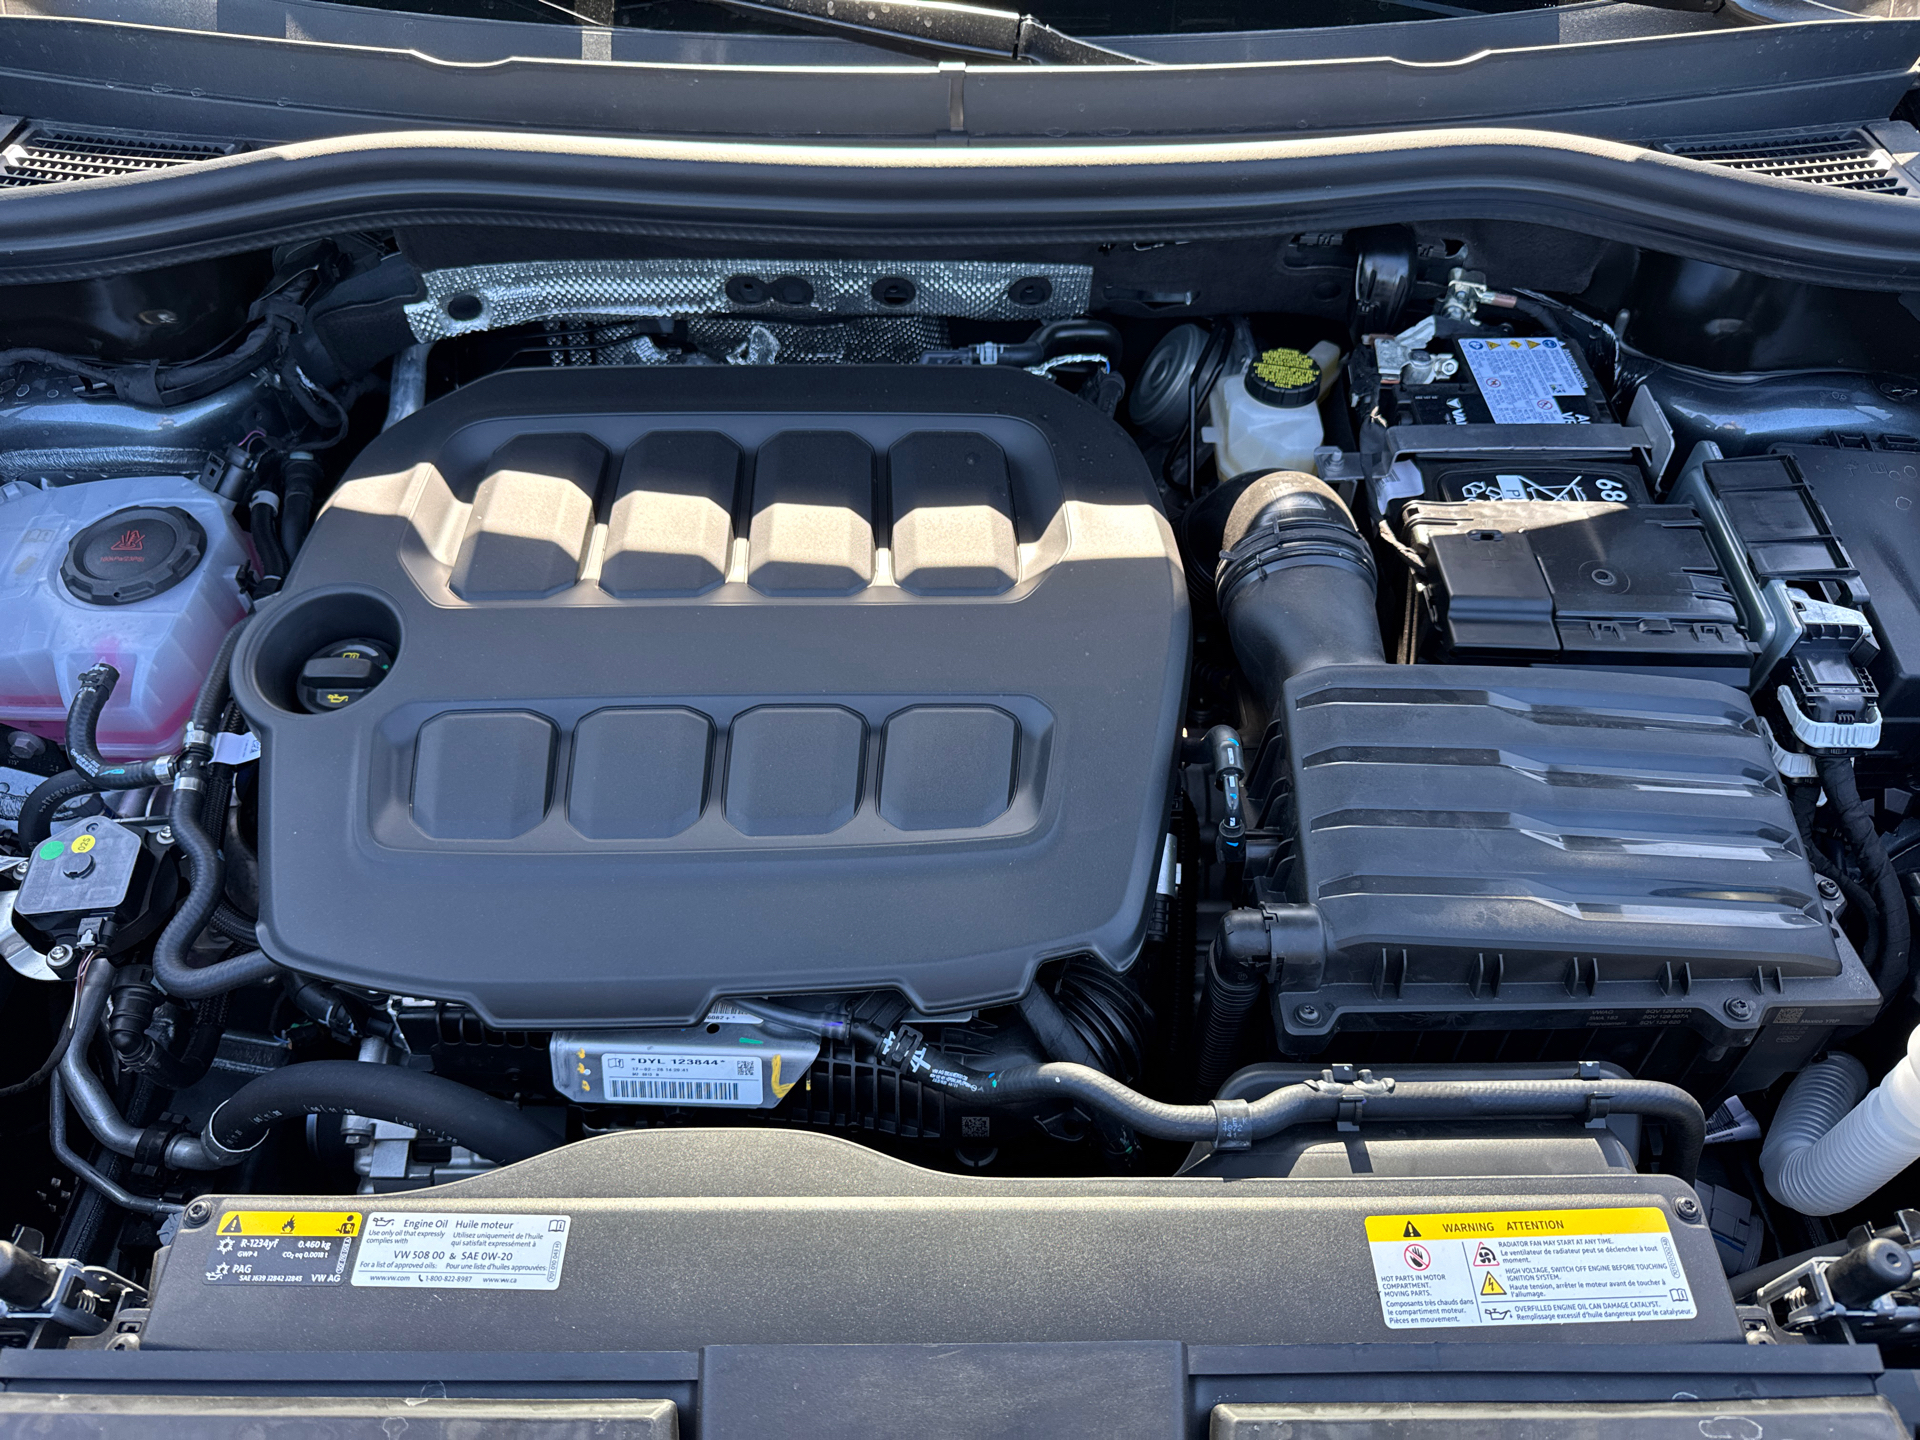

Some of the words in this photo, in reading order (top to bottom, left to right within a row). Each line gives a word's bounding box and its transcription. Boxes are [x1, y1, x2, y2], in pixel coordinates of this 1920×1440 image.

[1595, 478, 1629, 502] 68
[404, 1220, 434, 1230] Engine
[435, 1220, 448, 1228] Oil
[455, 1220, 479, 1229] Huile
[1442, 1222, 1494, 1233] WARNING
[1506, 1220, 1564, 1231] ATTENTION
[477, 1232, 515, 1241] uniquement
[240, 1238, 279, 1250] R-1234yf
[298, 1240, 320, 1248] 0.460
[321, 1240, 331, 1250] kg
[488, 1240, 531, 1248] expressément
[394, 1250, 411, 1259] VW
[412, 1251, 430, 1259] 508
[432, 1251, 445, 1260] 00
[461, 1252, 479, 1260] SAE
[481, 1252, 513, 1261] 0W-20
[232, 1264, 252, 1274] PAG
[394, 1262, 423, 1270] approved
[511, 1264, 548, 1272] approuvées:
[311, 1274, 327, 1282] VW
[327, 1274, 341, 1282] AG
[1386, 1300, 1424, 1308] Composants
[1517, 1313, 1556, 1321] Remplissage
